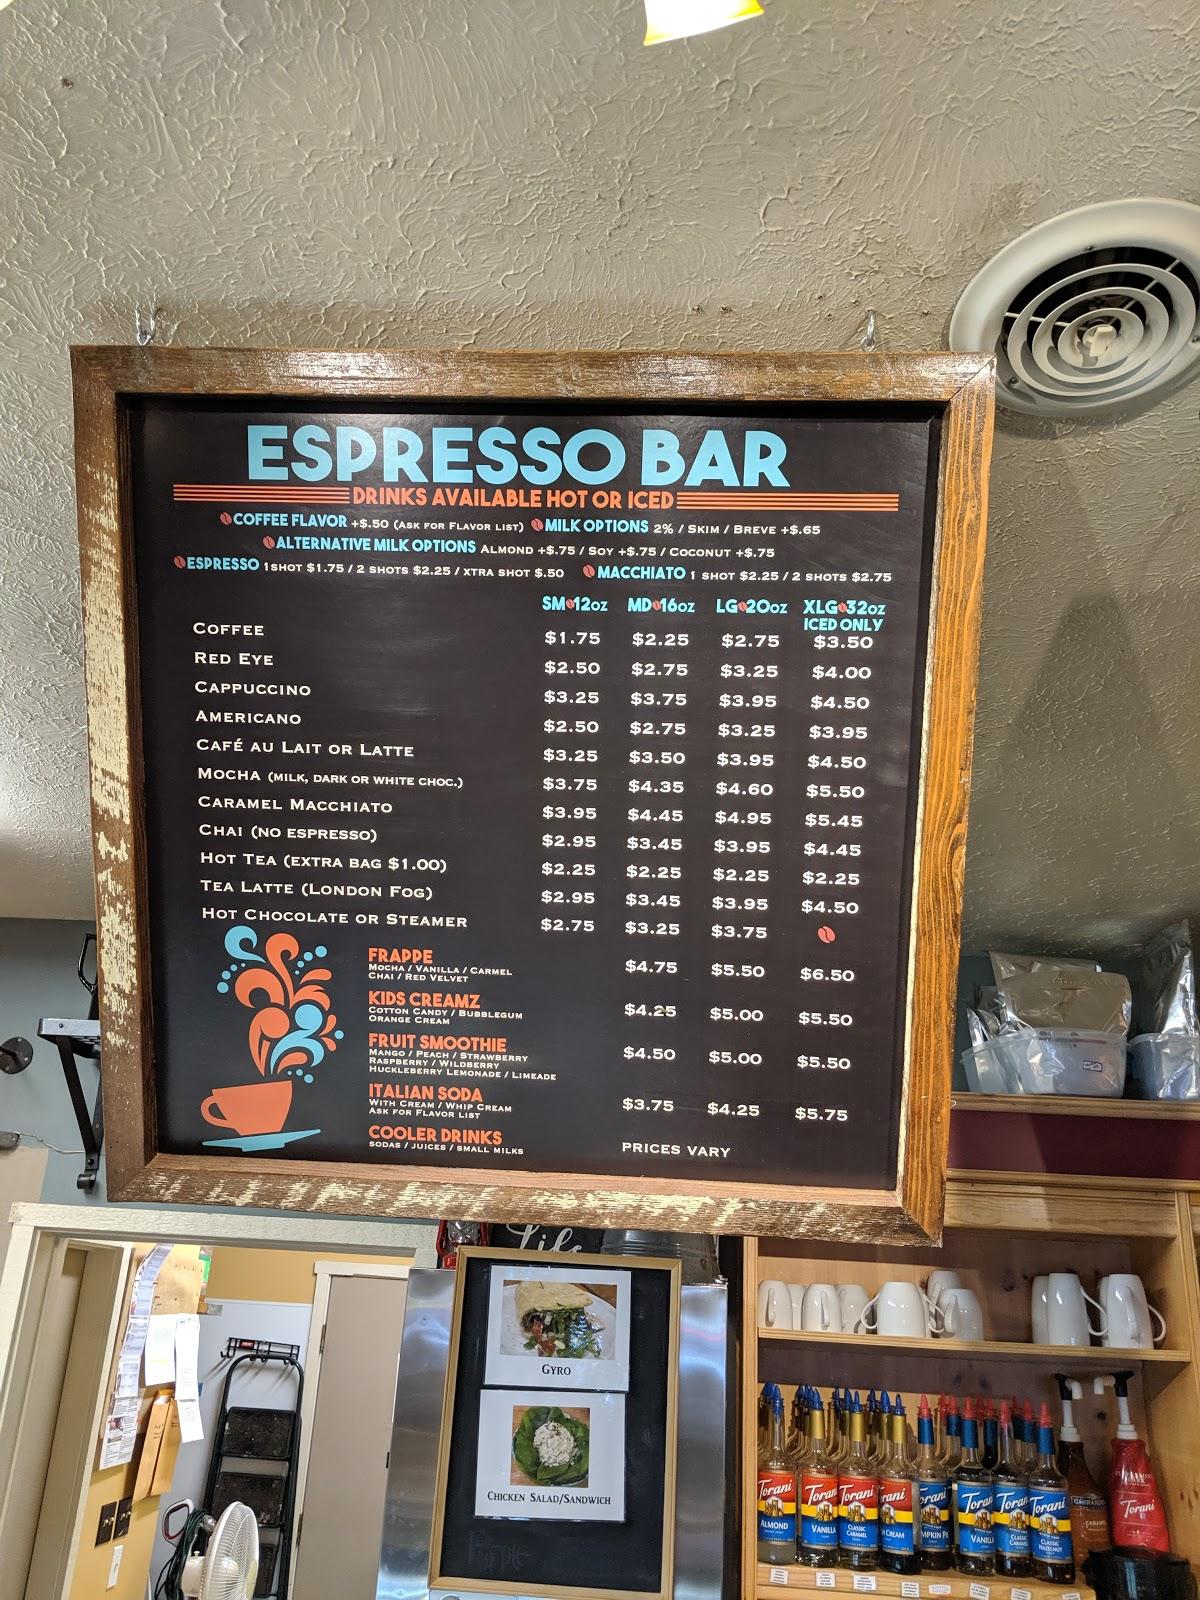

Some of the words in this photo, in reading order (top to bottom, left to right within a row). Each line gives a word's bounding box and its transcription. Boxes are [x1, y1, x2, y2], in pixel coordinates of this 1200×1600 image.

[248, 424, 626, 485] ESPRESSO
[641, 430, 790, 487] BAR
[353, 487, 427, 505] DRINKS
[432, 488, 541, 507] AVAILABLE
[547, 490, 588, 508] HOT
[592, 491, 622, 508] OR
[628, 491, 674, 509] ICED
[234, 513, 288, 526] COFFEE
[292, 514, 347, 527] FLAVOR
[352, 518, 389, 529] +$.50
[394, 520, 420, 530] (ASK
[450, 522, 490, 530] FLAVOR
[496, 522, 523, 532] LIST)
[545, 519, 580, 532] MILK
[584, 520, 648, 533] OPTIONS
[654, 524, 673, 534] 2%
[688, 525, 719, 533] SKIM
[734, 525, 776, 534] BREVE
[781, 525, 820, 535] +$.65
[276, 536, 371, 550] ALTERNATIVE
[374, 538, 409, 551] MILK
[412, 540, 476, 553] OPTIONS
[481, 545, 533, 554] ALMOND
[538, 545, 575, 555] +$.75
[589, 547, 613, 555] SOY
[619, 546, 656, 557] +$.75
[670, 548, 731, 557] COCONUT
[736, 548, 774, 558] +$.75
[188, 557, 259, 570] ESPRESSO
[598, 566, 686, 579] MACCHIATO
[702, 572, 735, 580] SHOT
[740, 571, 778, 581] $2.25
[852, 572, 891, 582] $2.75
[194, 622, 264, 636] COFFEE
[804, 618, 837, 630] ICED
[840, 619, 883, 631] ONLY
[545, 630, 600, 645] $1.75
[633, 632, 688, 646] $2.25
[722, 634, 779, 648] $2.75
[814, 635, 873, 649] $3.50
[195, 652, 230, 664] RED
[240, 653, 273, 665] EYE
[195, 681, 310, 696] CAPPUCCINO
[196, 710, 301, 724] AMERICANO
[197, 738, 243, 751] CAFÉ
[251, 742, 273, 752] AU
[282, 742, 321, 754] LAIT
[329, 745, 352, 754] OR
[360, 744, 414, 756] LATTE
[198, 768, 260, 780] MOCHA
[268, 772, 308, 784] (MILK,
[314, 775, 347, 783] DARK
[351, 776, 368, 784] OR
[373, 776, 414, 785] WHITE
[419, 778, 463, 788] CHOC.)
[198, 796, 282, 809] CARAMEL
[290, 799, 392, 813] MACCHIATO
[543, 806, 596, 819] $3.95
[628, 808, 683, 822] $4.45
[715, 810, 771, 824] $4.95
[805, 813, 862, 827] $5.45
[200, 824, 242, 836] CHAI
[252, 826, 281, 839] (NO
[288, 828, 377, 843] ESPRESSO)
[201, 852, 236, 864] HOT
[243, 854, 276, 865] TEA
[284, 855, 343, 868] (EXTRA
[350, 858, 381, 868] BAG
[388, 857, 446, 873] $1.00)
[201, 880, 234, 892] TEA
[242, 882, 293, 894] LATTE
[302, 883, 381, 896] (LONDON
[390, 886, 432, 900] FOG)
[203, 908, 237, 919] HOT
[245, 909, 348, 923] CHOCOLATE
[356, 914, 378, 924] OR
[387, 914, 467, 927] STEAMER
[369, 948, 432, 964] FRAPPE
[416, 965, 459, 973] VANILLA
[470, 967, 512, 975] CARMEL
[626, 960, 677, 973] $4.75
[712, 963, 764, 977] $5.50
[800, 967, 854, 981] $6.50
[430, 974, 468, 982] VELVET
[369, 991, 406, 1005] KIDS
[410, 992, 480, 1008] CREAMZ
[369, 1006, 408, 1014] COTTON
[413, 1008, 447, 1016] CANDY
[459, 1010, 522, 1019] BUBBLEGUM
[369, 1015, 410, 1023] ORANGE
[369, 1034, 416, 1048] FRUIT
[420, 1035, 506, 1052] SMOOTHIE
[370, 1057, 428, 1066] RASPBERRY
[439, 1060, 499, 1069] WILDBERRY
[460, 1052, 528, 1062] STRAWBERRY
[370, 1066, 442, 1075] HUCKLEBERRY
[447, 1069, 501, 1077] LEMONADE
[512, 1072, 556, 1080] LIMEADE
[370, 1084, 433, 1099] ITALIAN
[438, 1087, 482, 1102] SODA
[400, 1100, 434, 1108] CREAM
[446, 1102, 473, 1110] WHIP
[477, 1104, 511, 1112] CREAM
[416, 1109, 454, 1117] FLAVOR
[369, 1126, 436, 1141] COOLER
[442, 1128, 502, 1144] DRINKS
[622, 1142, 680, 1154] PRICES
[687, 1146, 730, 1157] VARY
[542, 1363, 571, 1376] GYRO
[488, 1491, 525, 1502] CHICKEN
[758, 1479, 792, 1500] Torani
[805, 1484, 837, 1505] Toran
[840, 1484, 874, 1505] Torani
[962, 1492, 992, 1514] Toran
[997, 1492, 1027, 1514] Toran
[1030, 1496, 1065, 1517] Torani
[1120, 1500, 1155, 1518] Torani
[761, 1520, 788, 1529] ALMOND
